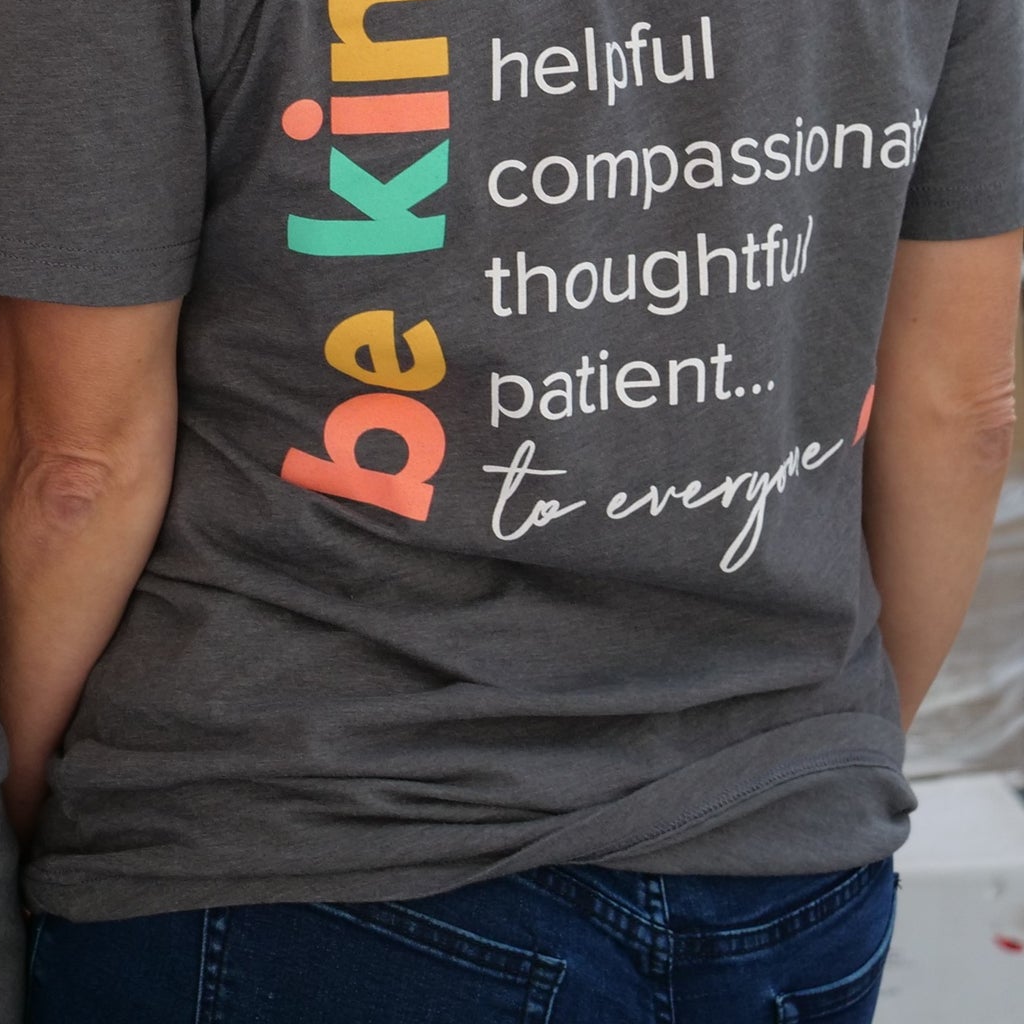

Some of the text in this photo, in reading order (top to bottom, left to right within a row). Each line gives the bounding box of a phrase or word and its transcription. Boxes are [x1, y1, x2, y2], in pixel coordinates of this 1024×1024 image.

[492, 16, 715, 106] helpful
[487, 107, 928, 210] compassionat
[484, 214, 814, 317] thoughtful
[280, 309, 448, 523] be
[490, 342, 776, 428] patient...
[482, 438, 844, 574] to everyone
